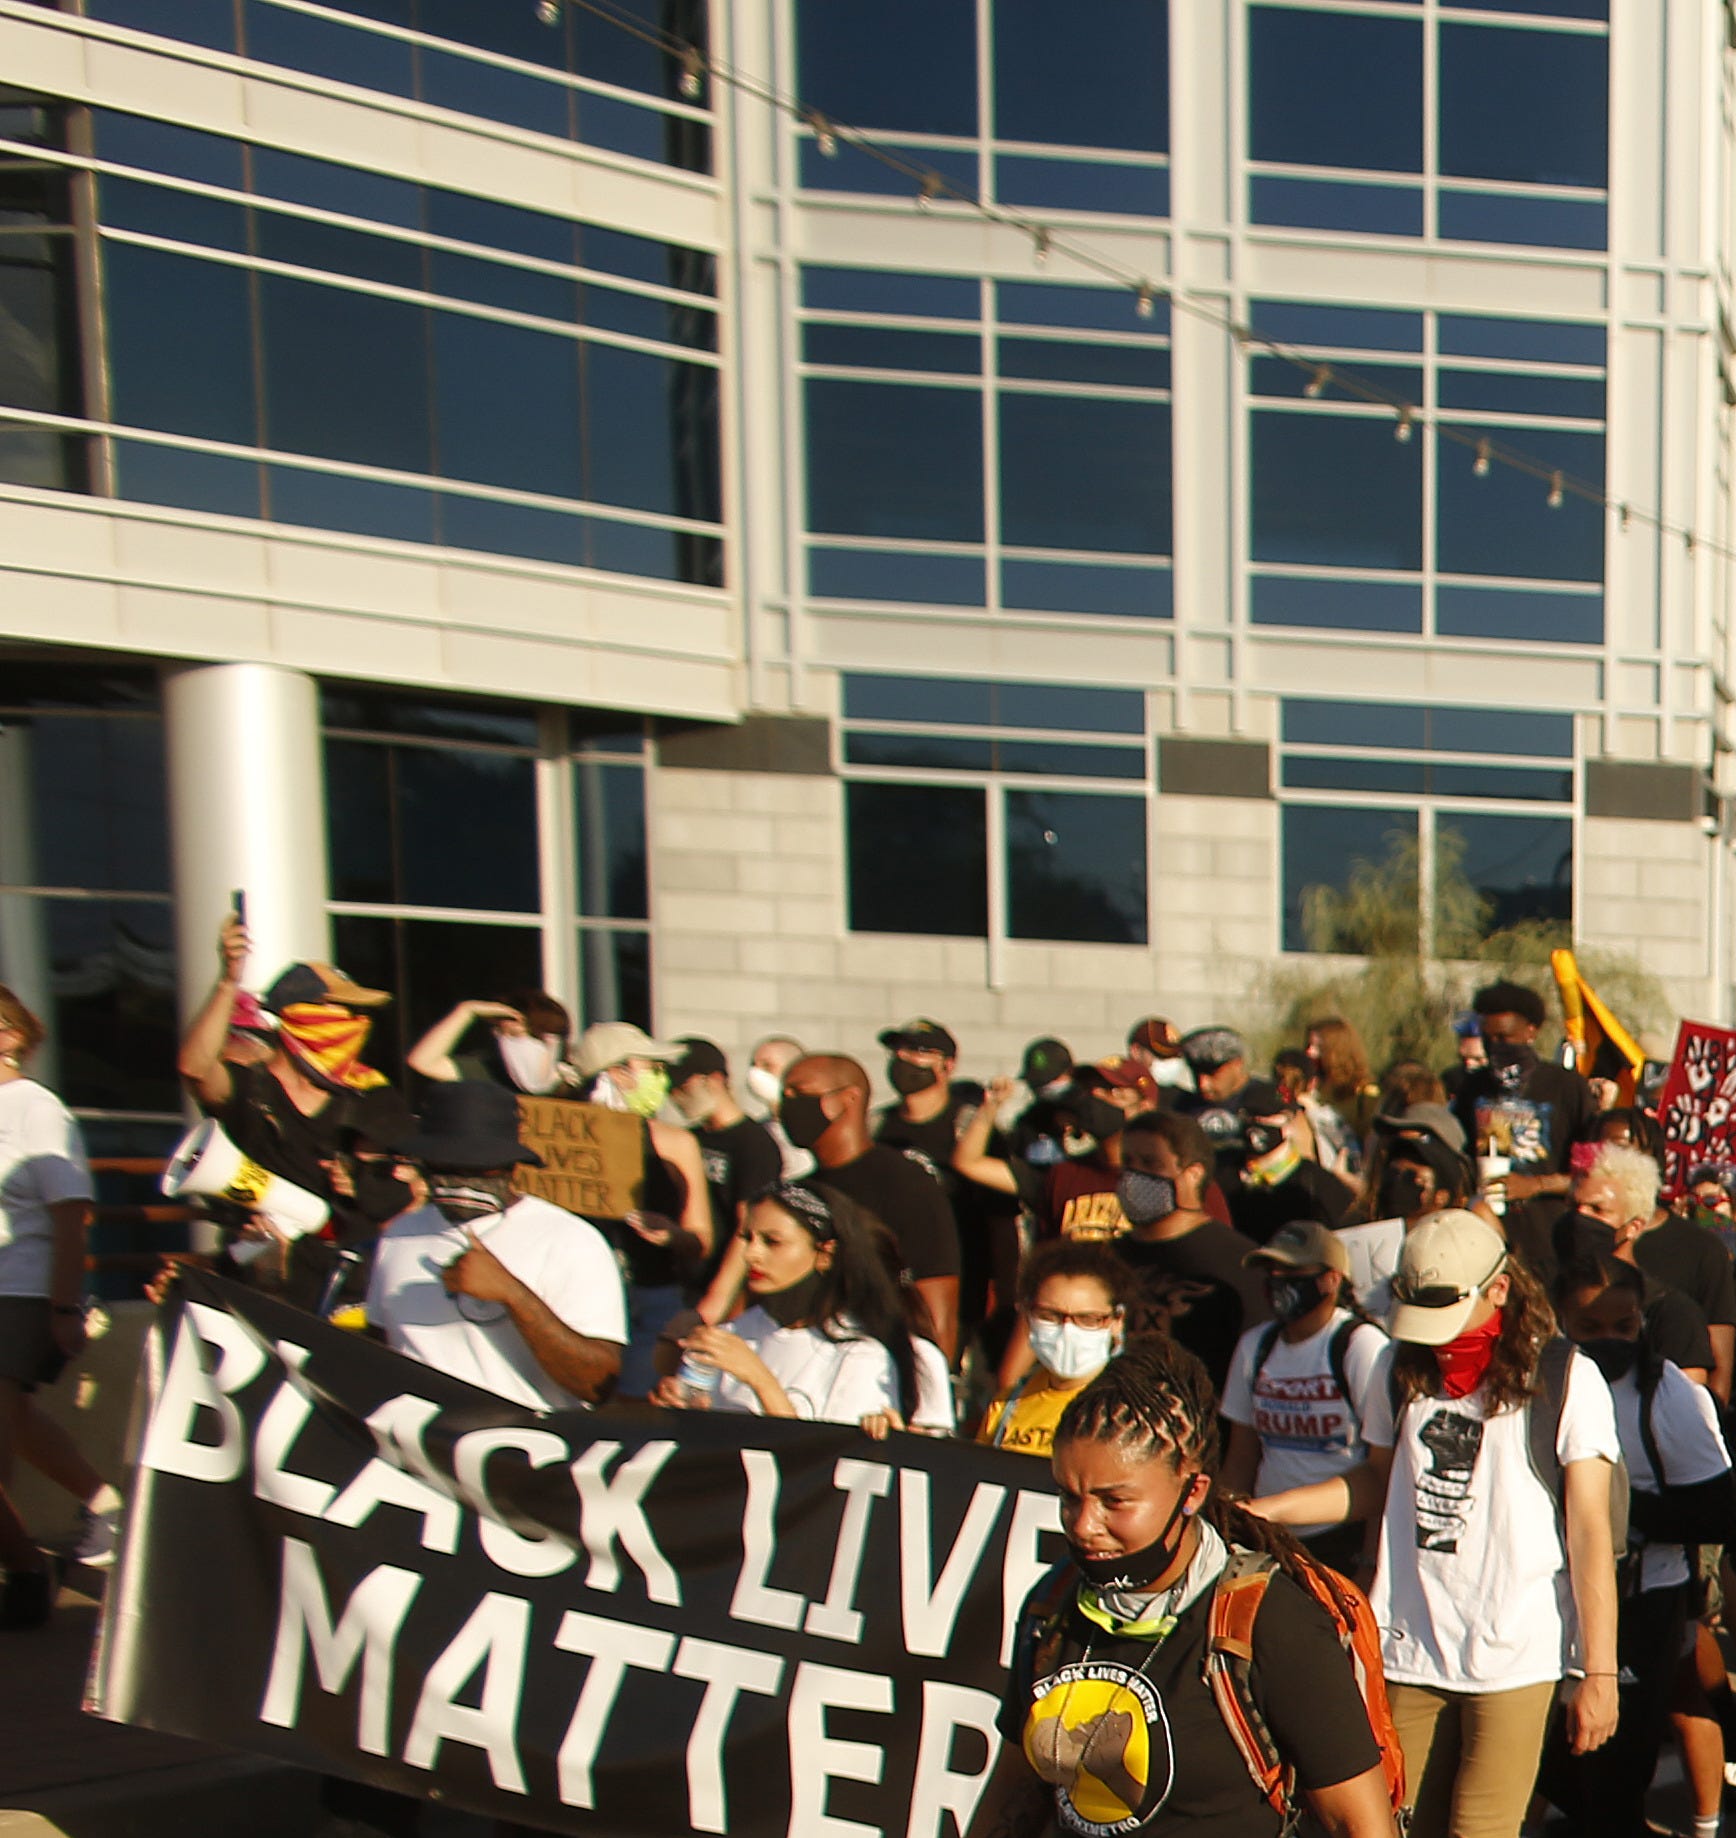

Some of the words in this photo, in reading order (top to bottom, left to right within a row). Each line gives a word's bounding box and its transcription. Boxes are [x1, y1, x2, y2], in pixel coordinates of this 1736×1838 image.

[1254, 1410, 1344, 1437] RUMP
[140, 1300, 680, 1610] BLACK
[1033, 1666, 1085, 1700] BLACK
[1087, 1666, 1127, 1684] LIVES
[1127, 1674, 1160, 1725] MATTER
